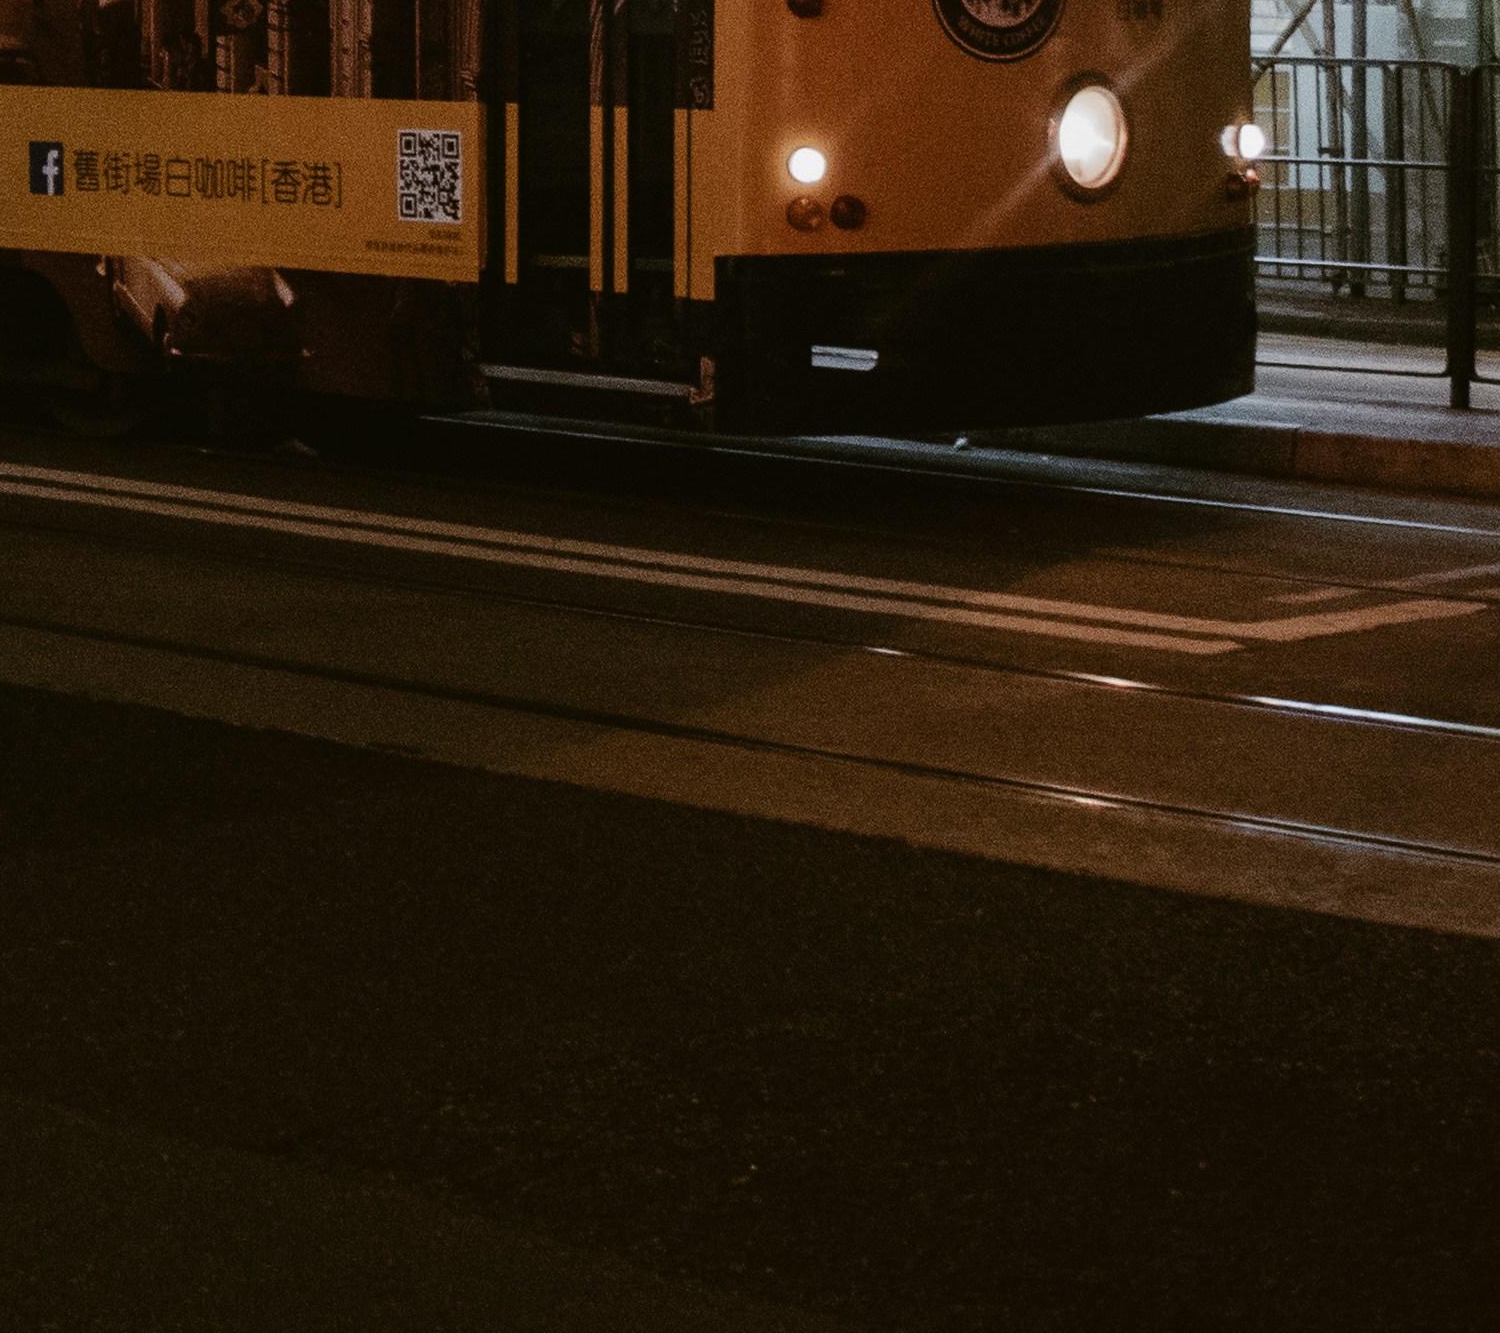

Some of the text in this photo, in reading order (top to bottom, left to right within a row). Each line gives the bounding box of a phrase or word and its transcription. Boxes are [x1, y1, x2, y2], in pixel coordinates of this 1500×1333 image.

[72, 148, 343, 209] 舊街場白咖啡[香港]
